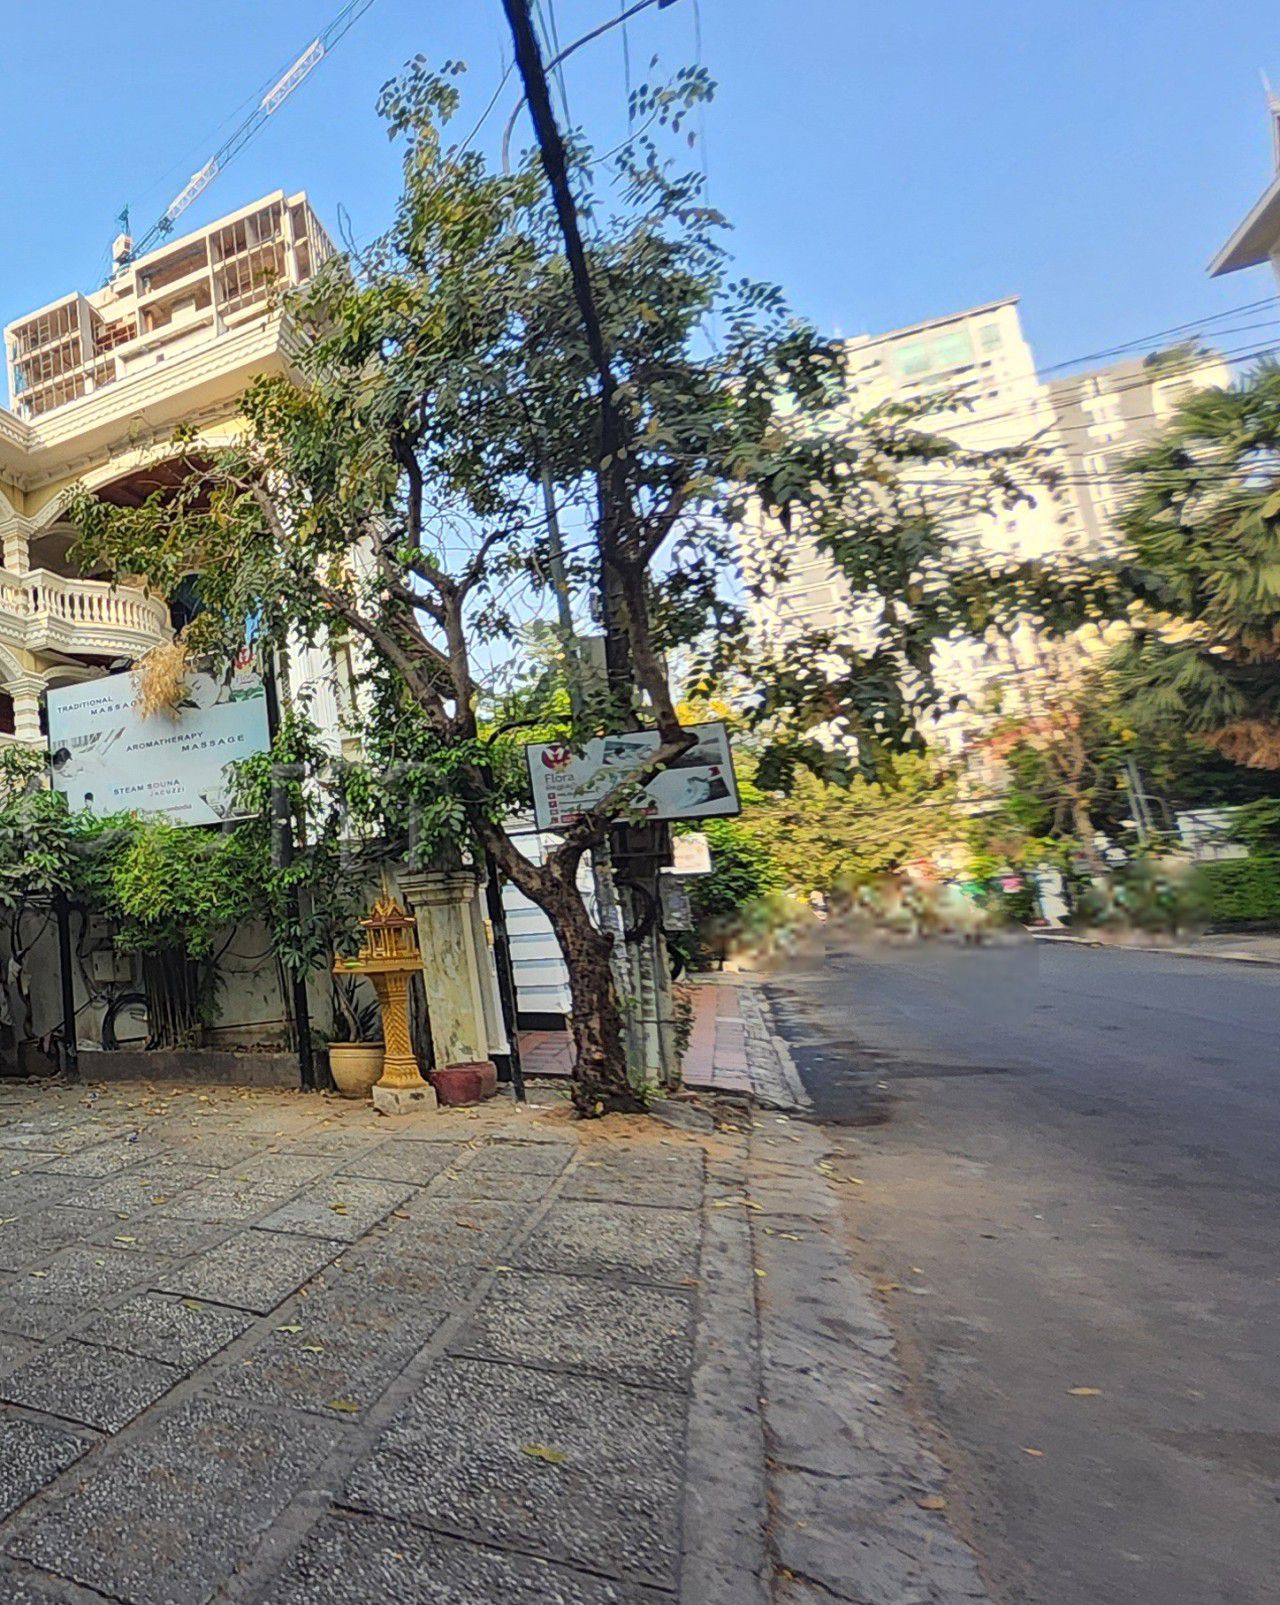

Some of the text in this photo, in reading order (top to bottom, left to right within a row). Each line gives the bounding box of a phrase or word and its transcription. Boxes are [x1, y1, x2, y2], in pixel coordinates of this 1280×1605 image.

[57, 696, 113, 714] TRADITIONAL
[125, 731, 204, 753] AROMATHERAPY
[181, 734, 245, 752] MASSAGE
[113, 778, 181, 796] STEAM SOUNA
[544, 773, 575, 784] Flora
